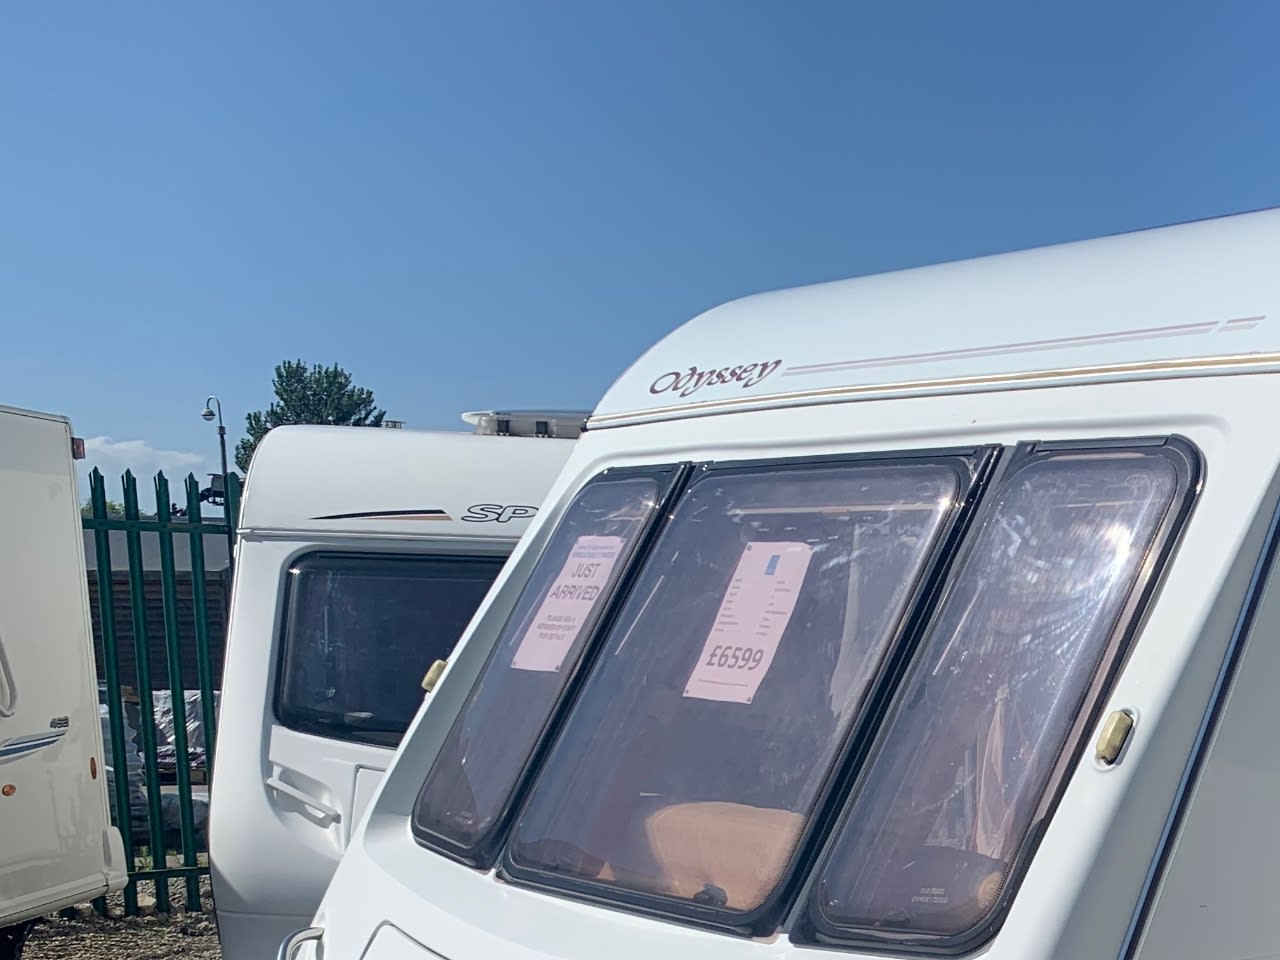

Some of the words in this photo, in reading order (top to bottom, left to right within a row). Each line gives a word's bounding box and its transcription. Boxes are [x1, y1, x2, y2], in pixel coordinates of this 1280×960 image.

[650, 359, 782, 398] Odyssey
[571, 562, 601, 578] JUST
[550, 584, 600, 601] ARRIVED
[705, 644, 764, 672] £6599
